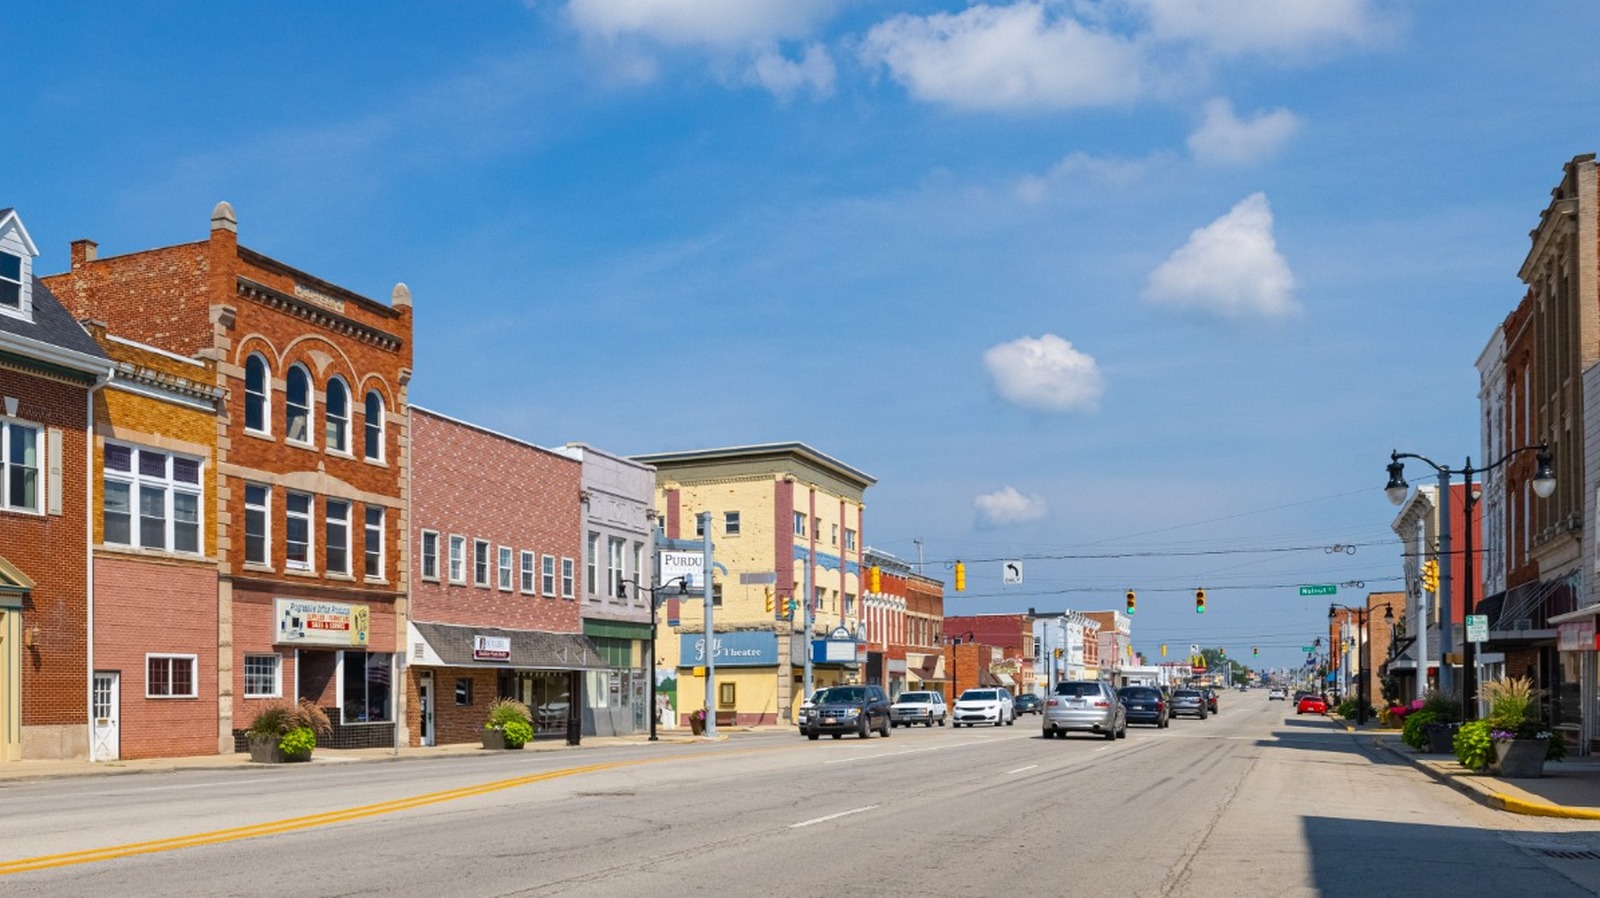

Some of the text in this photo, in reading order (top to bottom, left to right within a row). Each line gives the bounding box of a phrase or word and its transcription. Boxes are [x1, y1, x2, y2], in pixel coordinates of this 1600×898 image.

[665, 554, 703, 567] PURDU
[317, 604, 331, 614] Office
[723, 648, 762, 657] Theatre
